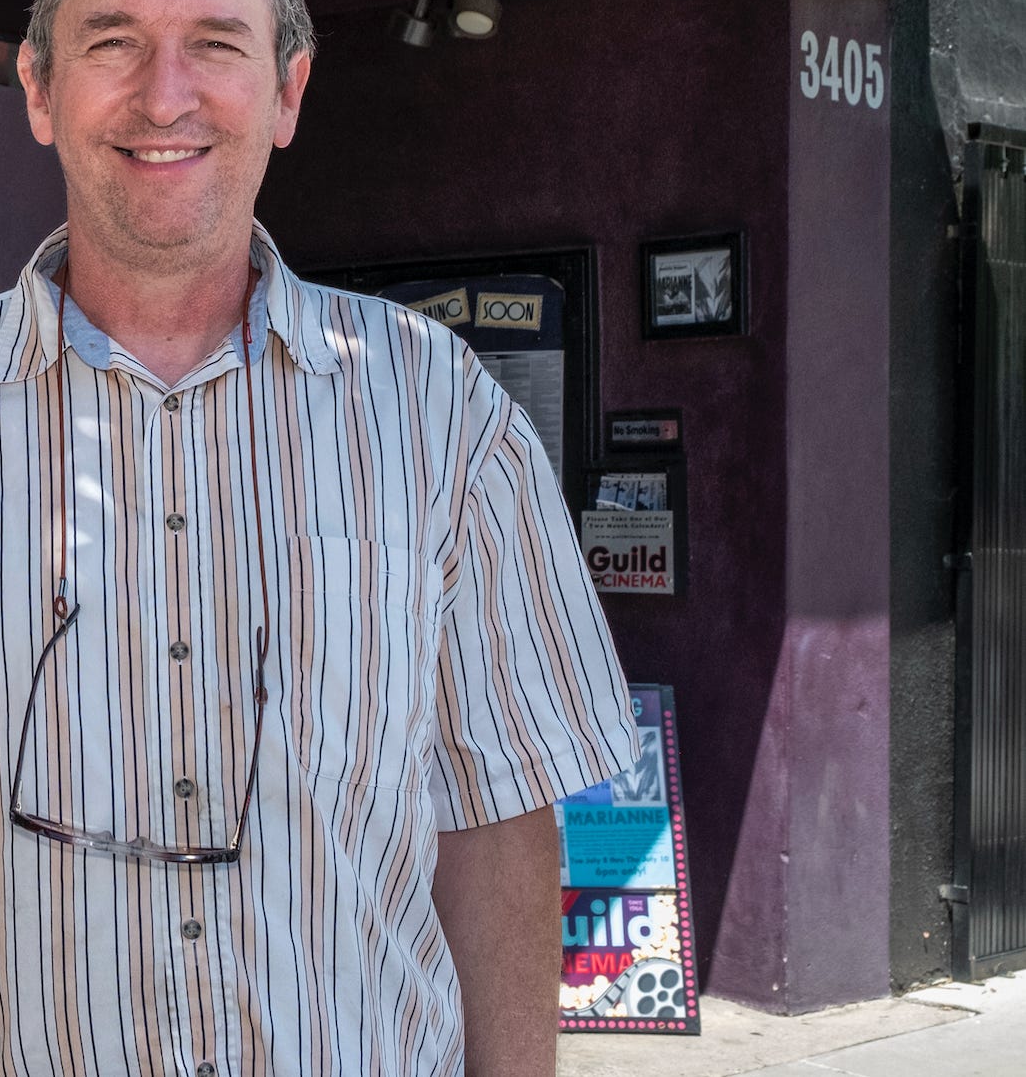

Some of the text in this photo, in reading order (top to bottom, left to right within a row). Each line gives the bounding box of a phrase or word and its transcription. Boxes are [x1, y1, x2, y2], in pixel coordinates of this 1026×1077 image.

[799, 30, 884, 110] 3405
[483, 300, 534, 322] SOON
[614, 425, 660, 436] No Smoking
[587, 545, 666, 573] Guild
[602, 574, 666, 588] CINEMA
[567, 809, 665, 826] MARIANNE
[595, 868, 618, 878] 6pm
[561, 897, 656, 947] uild
